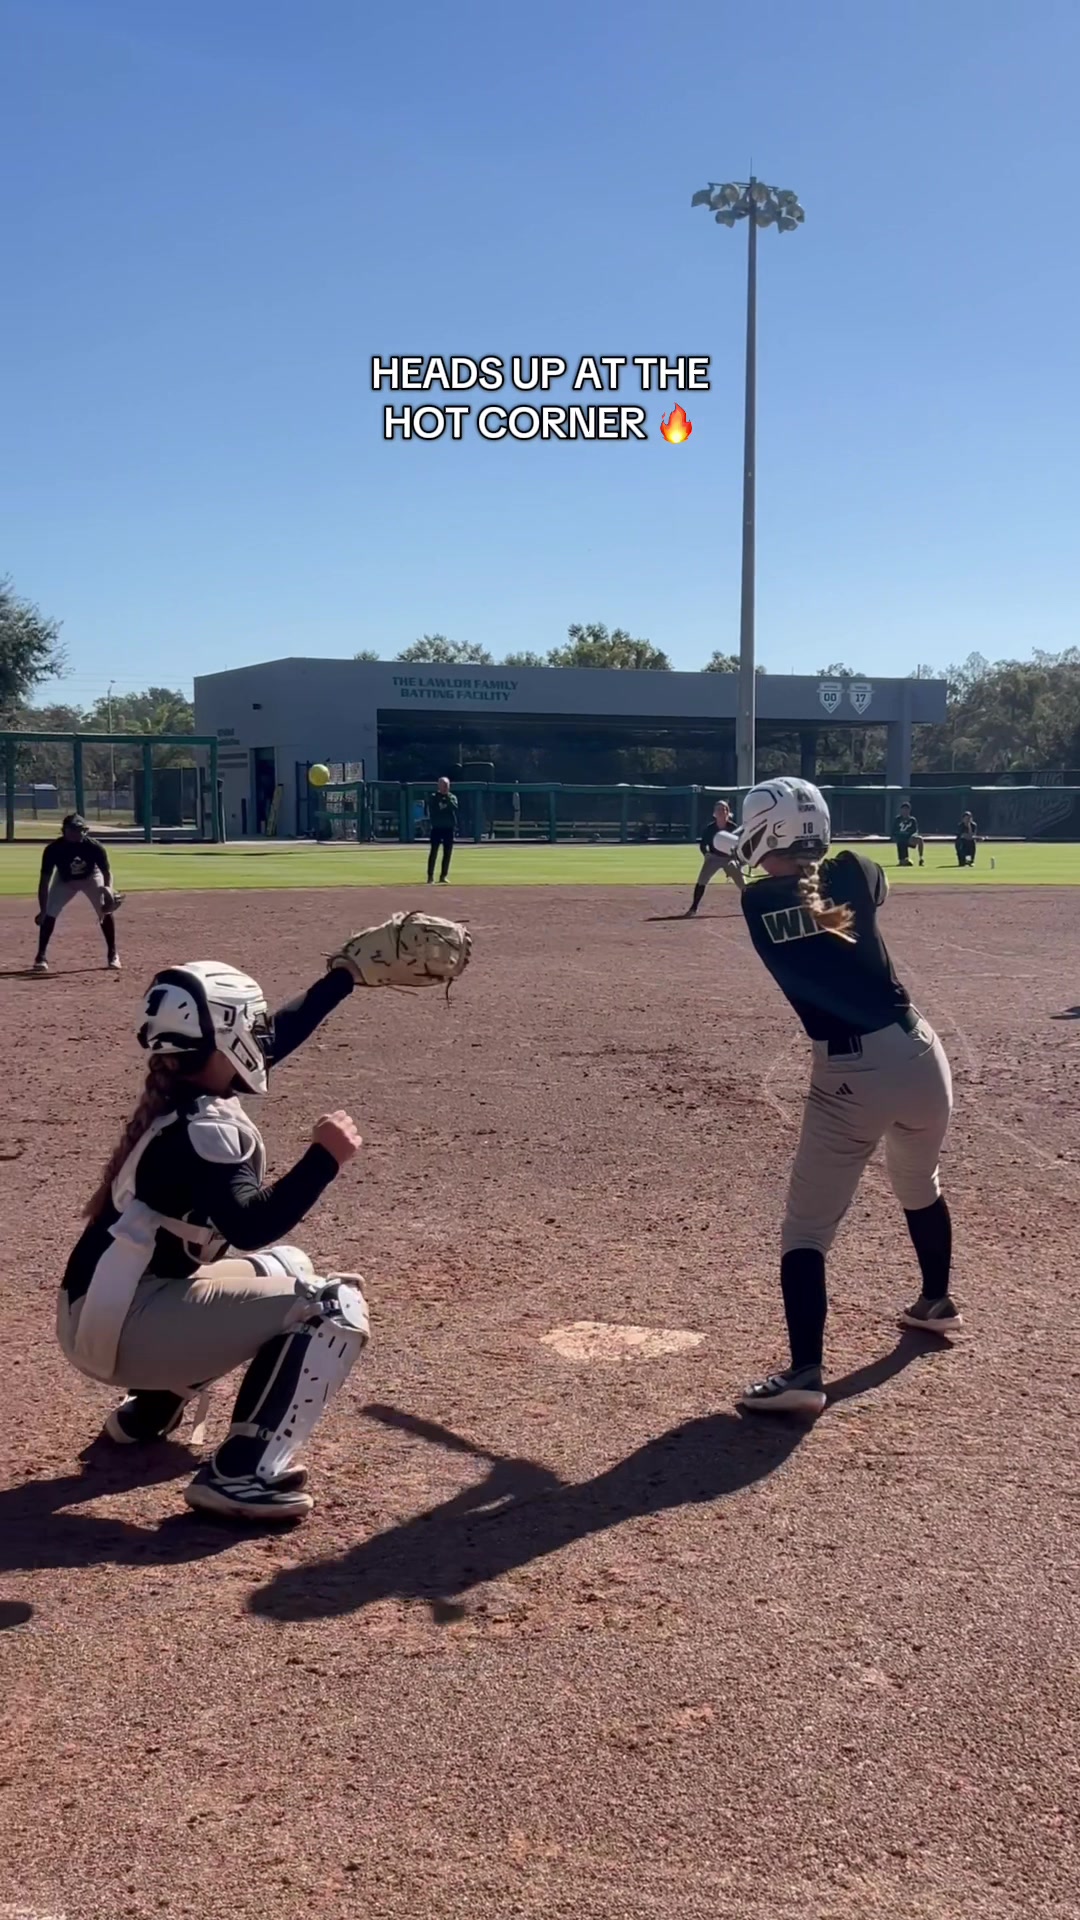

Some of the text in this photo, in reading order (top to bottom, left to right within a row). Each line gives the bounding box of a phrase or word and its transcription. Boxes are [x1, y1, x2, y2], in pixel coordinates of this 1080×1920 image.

[392, 676, 518, 690] THE LAWLOR FAMILY
[400, 688, 511, 701] BATTING FACILITY
[824, 693, 837, 702] 00
[855, 693, 866, 703] 17
